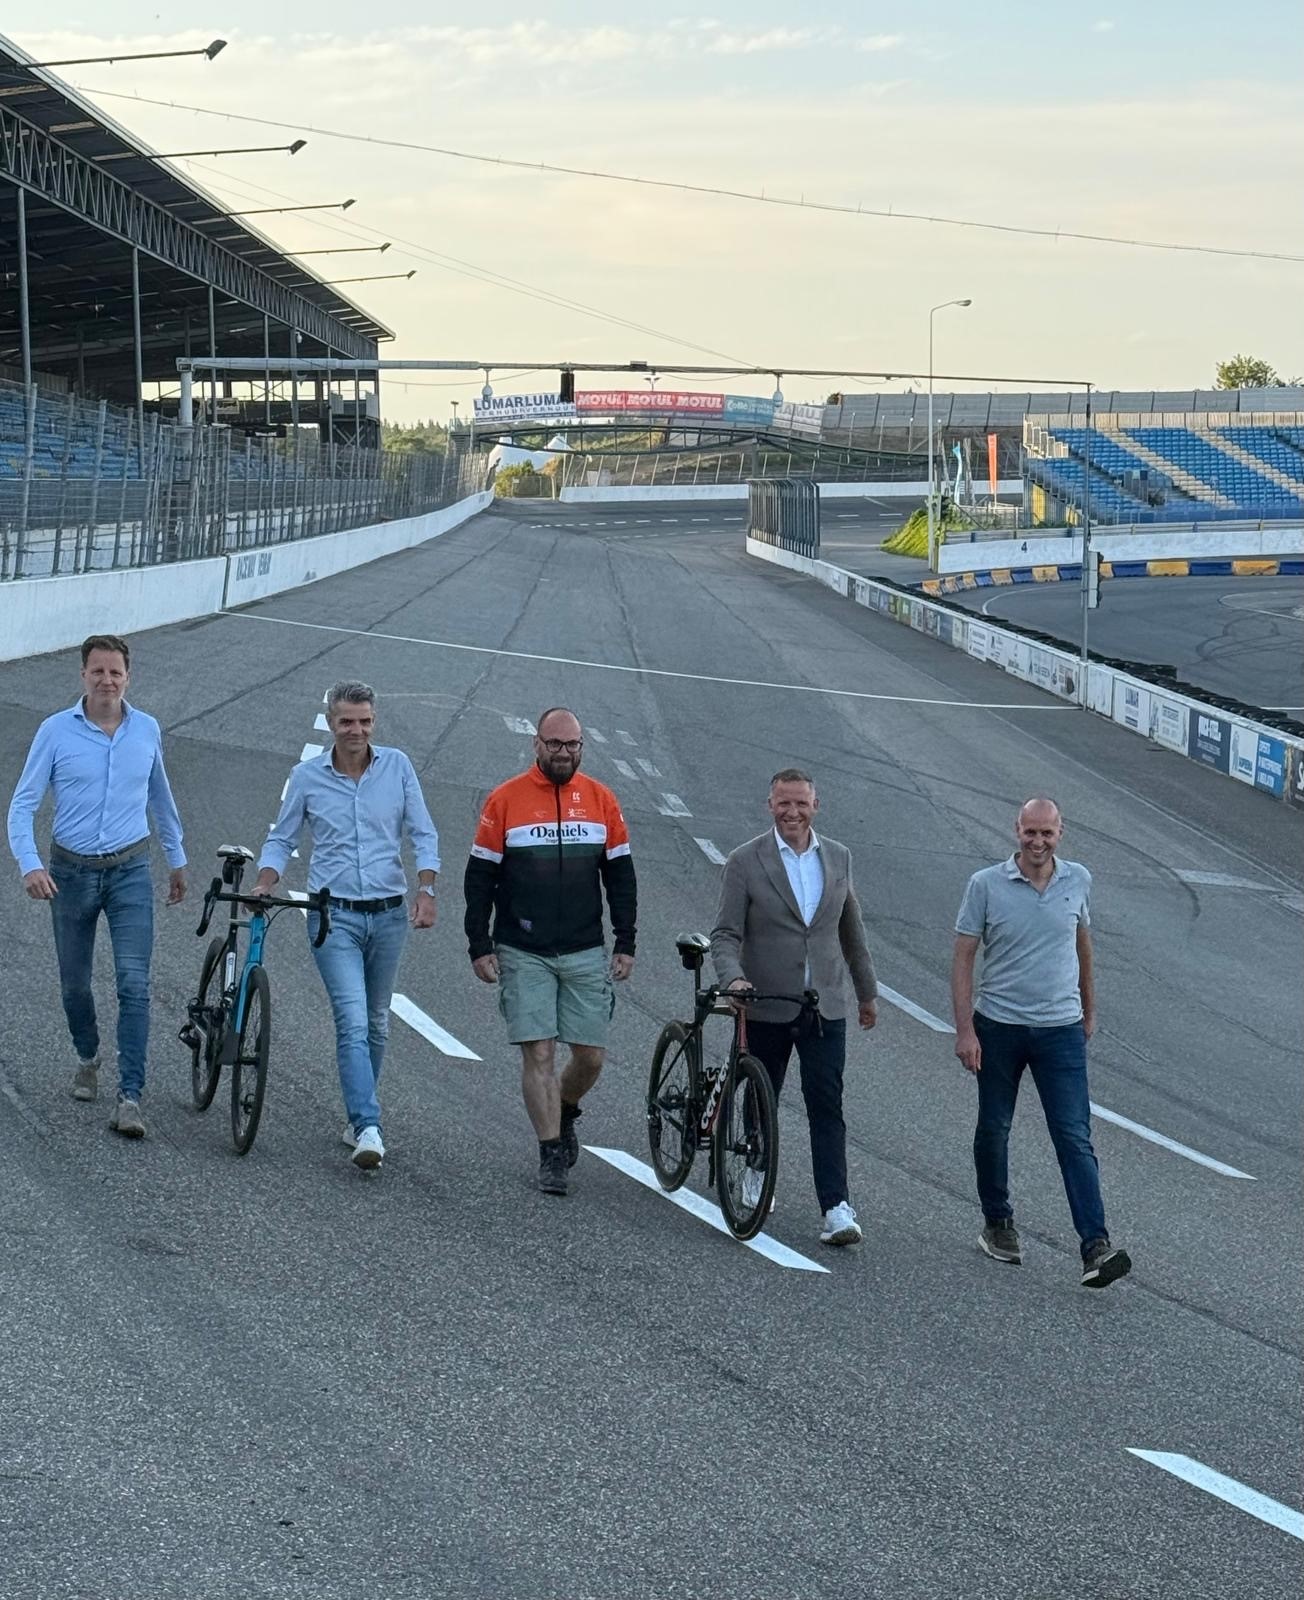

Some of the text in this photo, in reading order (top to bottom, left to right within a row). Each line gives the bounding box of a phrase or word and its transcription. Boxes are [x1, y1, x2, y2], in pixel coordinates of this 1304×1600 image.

[474, 394, 573, 411] LUMAR LUMA
[578, 394, 722, 408] MOTUL MOTUL MOTUL
[475, 407, 525, 417] VERHUUR
[1021, 541, 1028, 553] 4
[530, 824, 588, 838] Daniels
